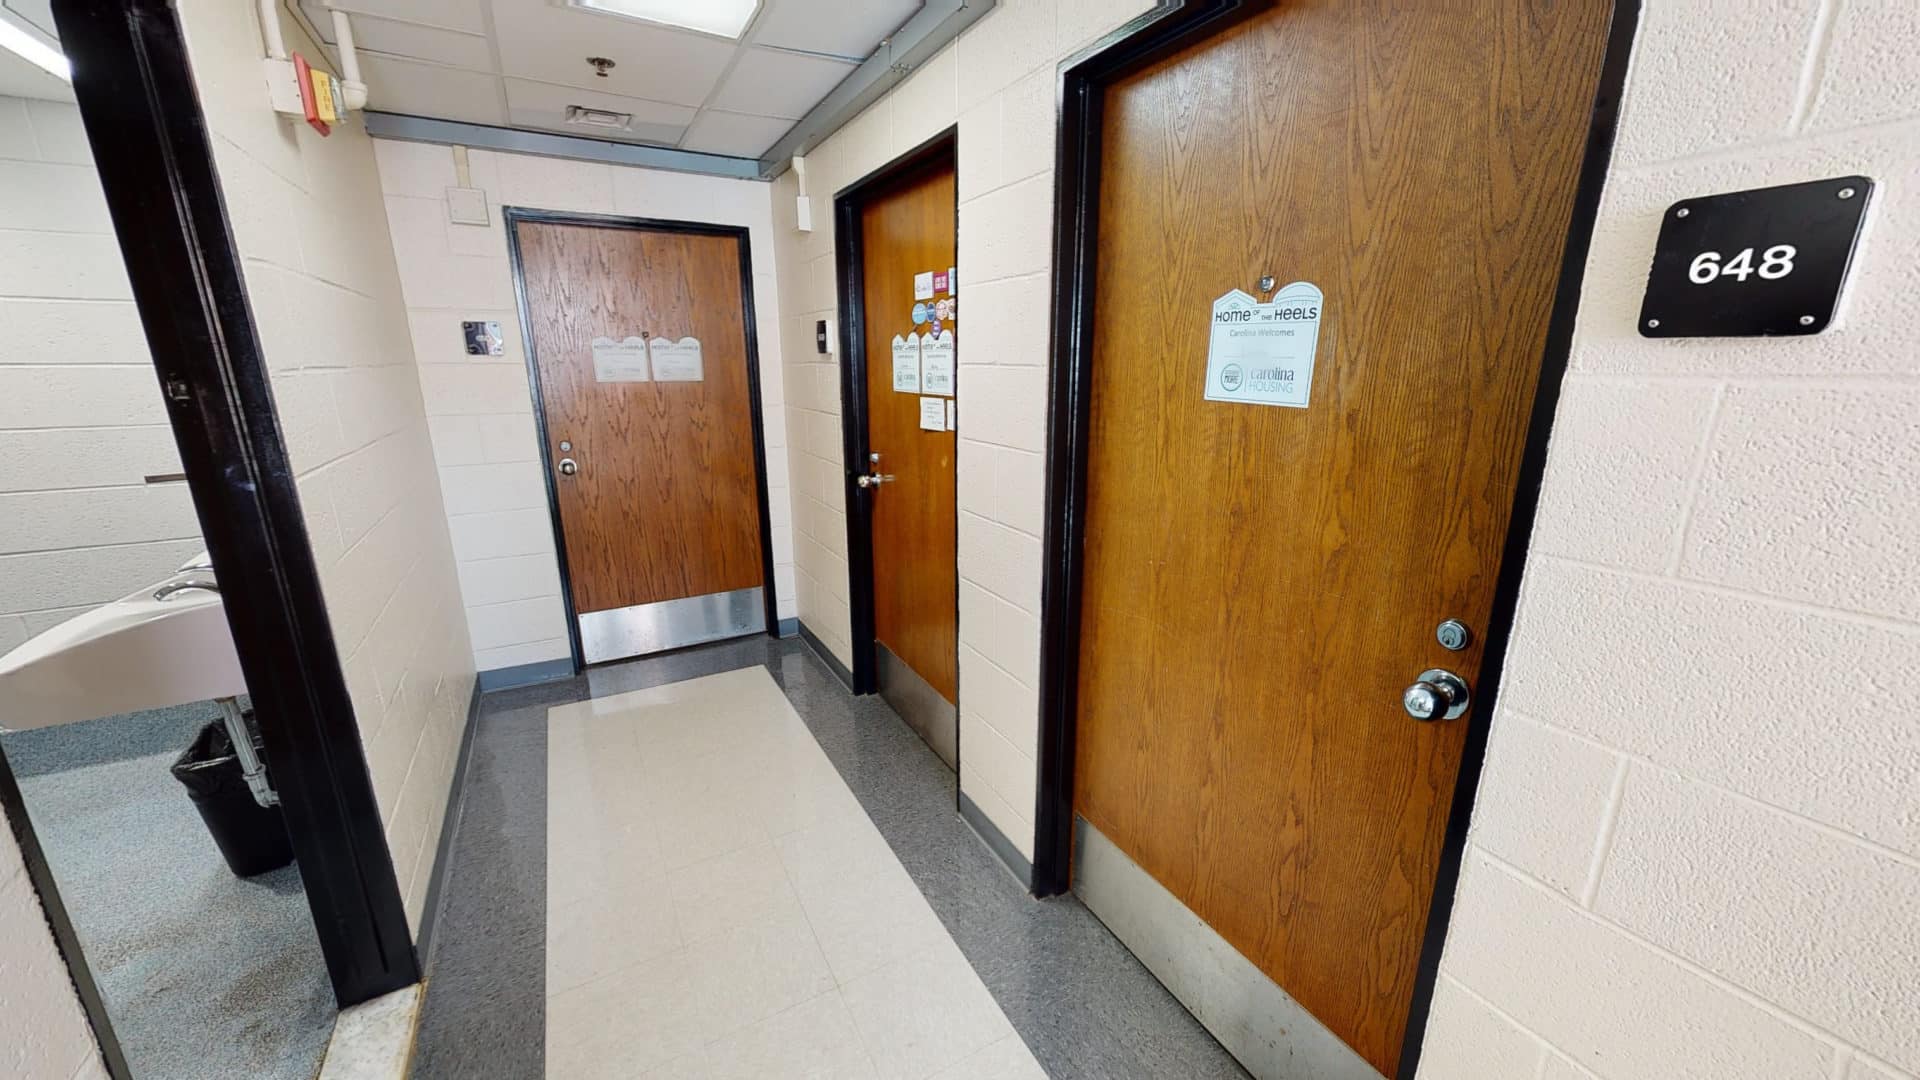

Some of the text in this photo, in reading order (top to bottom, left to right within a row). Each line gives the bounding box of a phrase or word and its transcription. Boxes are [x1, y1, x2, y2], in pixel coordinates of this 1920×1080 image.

[1688, 244, 1797, 285] 648
[1229, 328, 1295, 337] Carolina Welcomes
[1250, 366, 1295, 382] carolina
[1248, 381, 1294, 394] HOUSING
